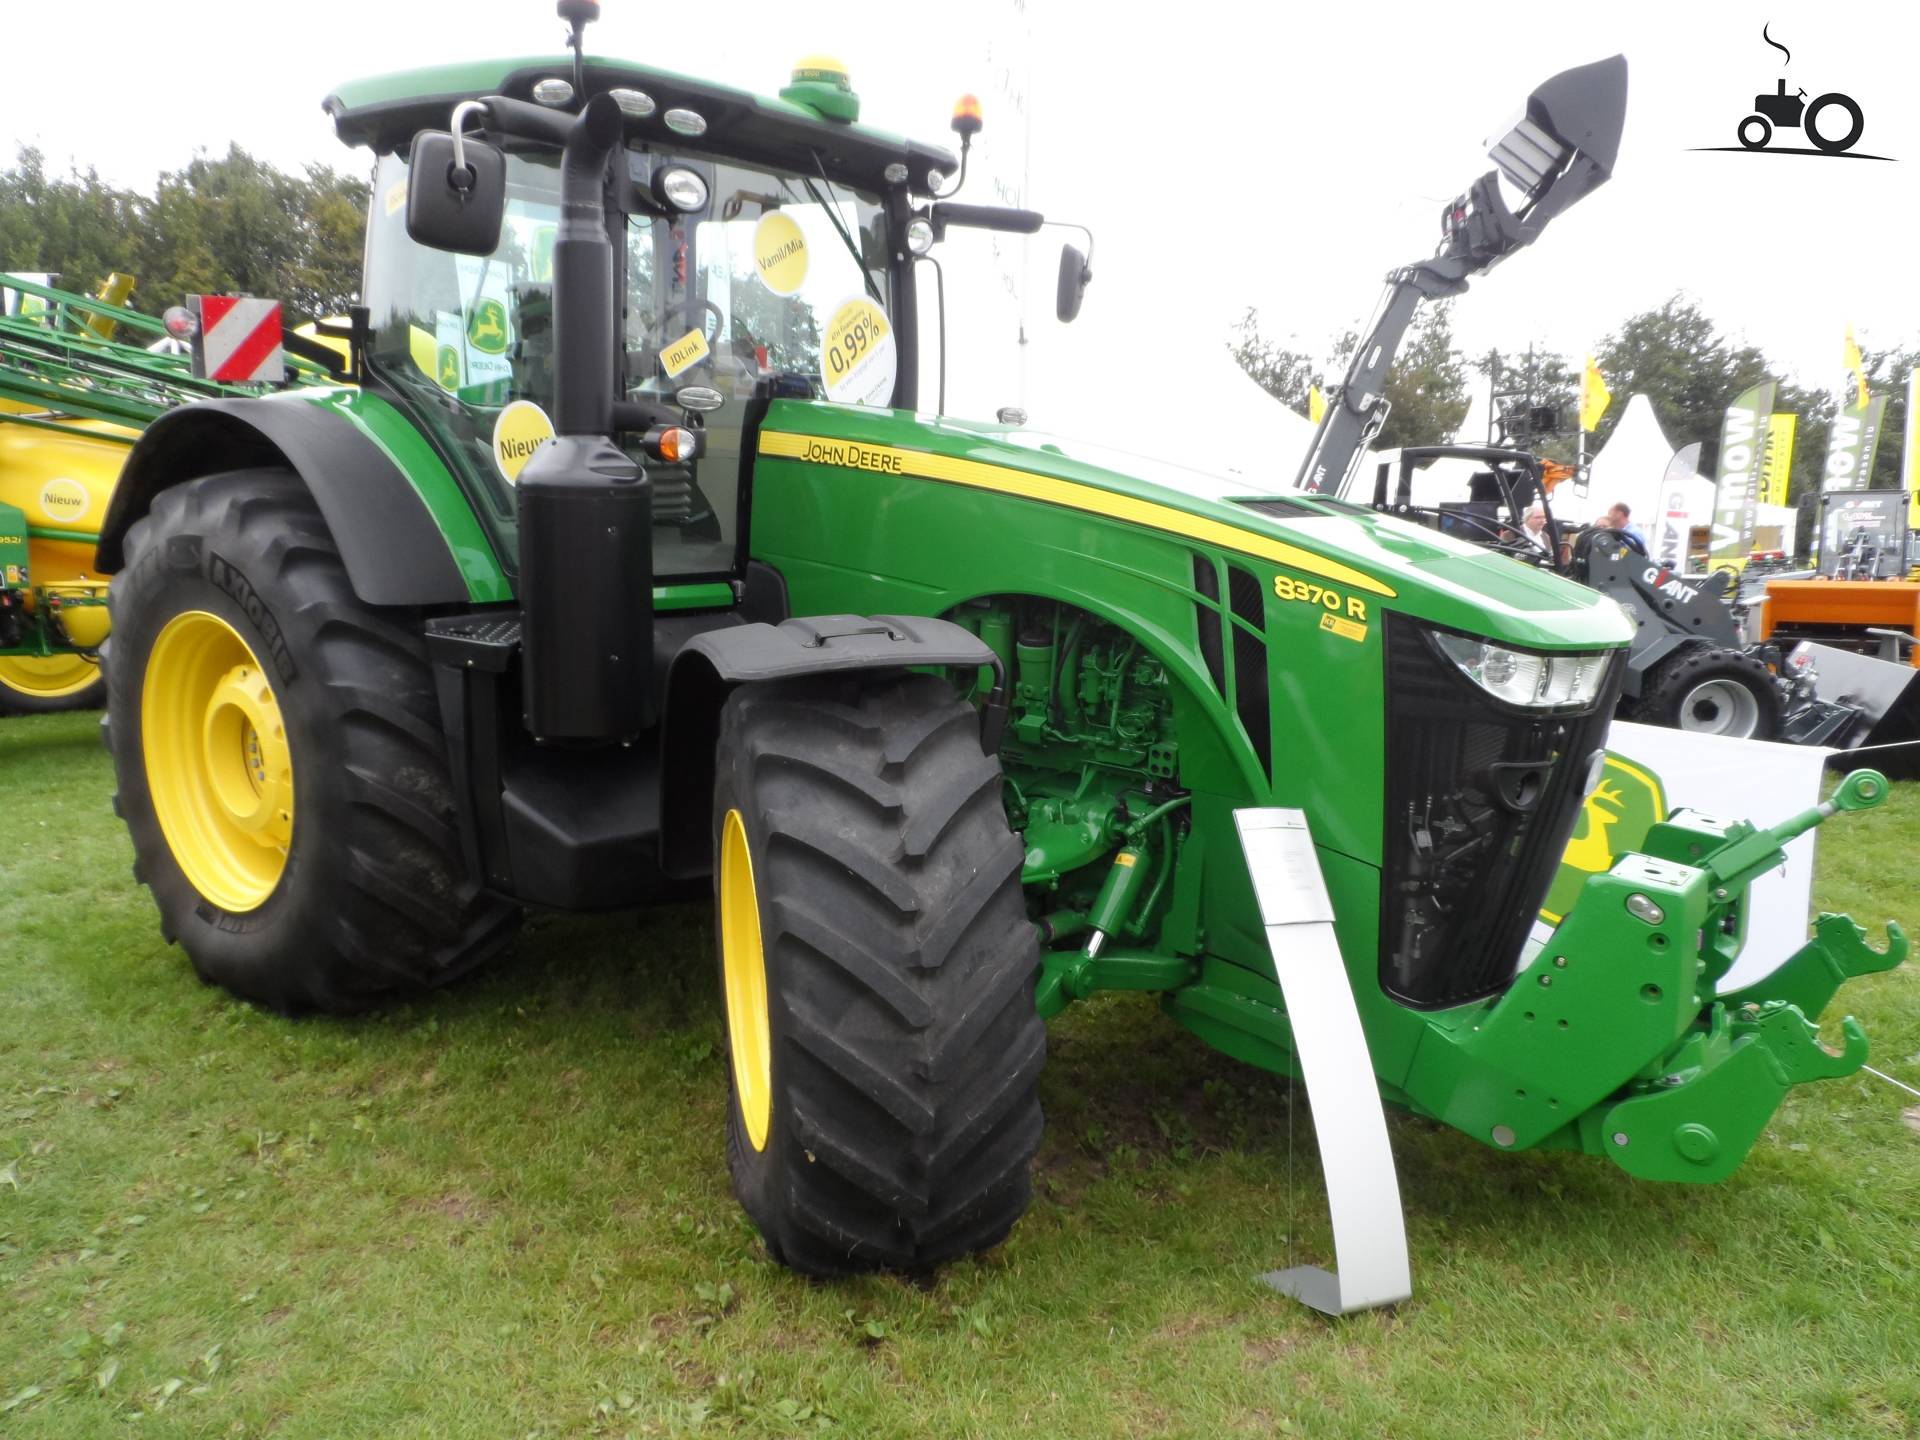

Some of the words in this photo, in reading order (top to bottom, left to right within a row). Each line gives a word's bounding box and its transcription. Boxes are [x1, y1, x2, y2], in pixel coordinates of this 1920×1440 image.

[758, 238, 804, 271] Vamil/Mia
[670, 341, 700, 367] JDLink
[829, 313, 880, 373] 0,99%
[802, 439, 845, 462] JOHN
[847, 446, 903, 472] DEERE
[44, 493, 82, 506] Nieuw
[1660, 492, 1689, 559] GIAN
[1274, 576, 1341, 610] 8370
[1347, 596, 1366, 621] R
